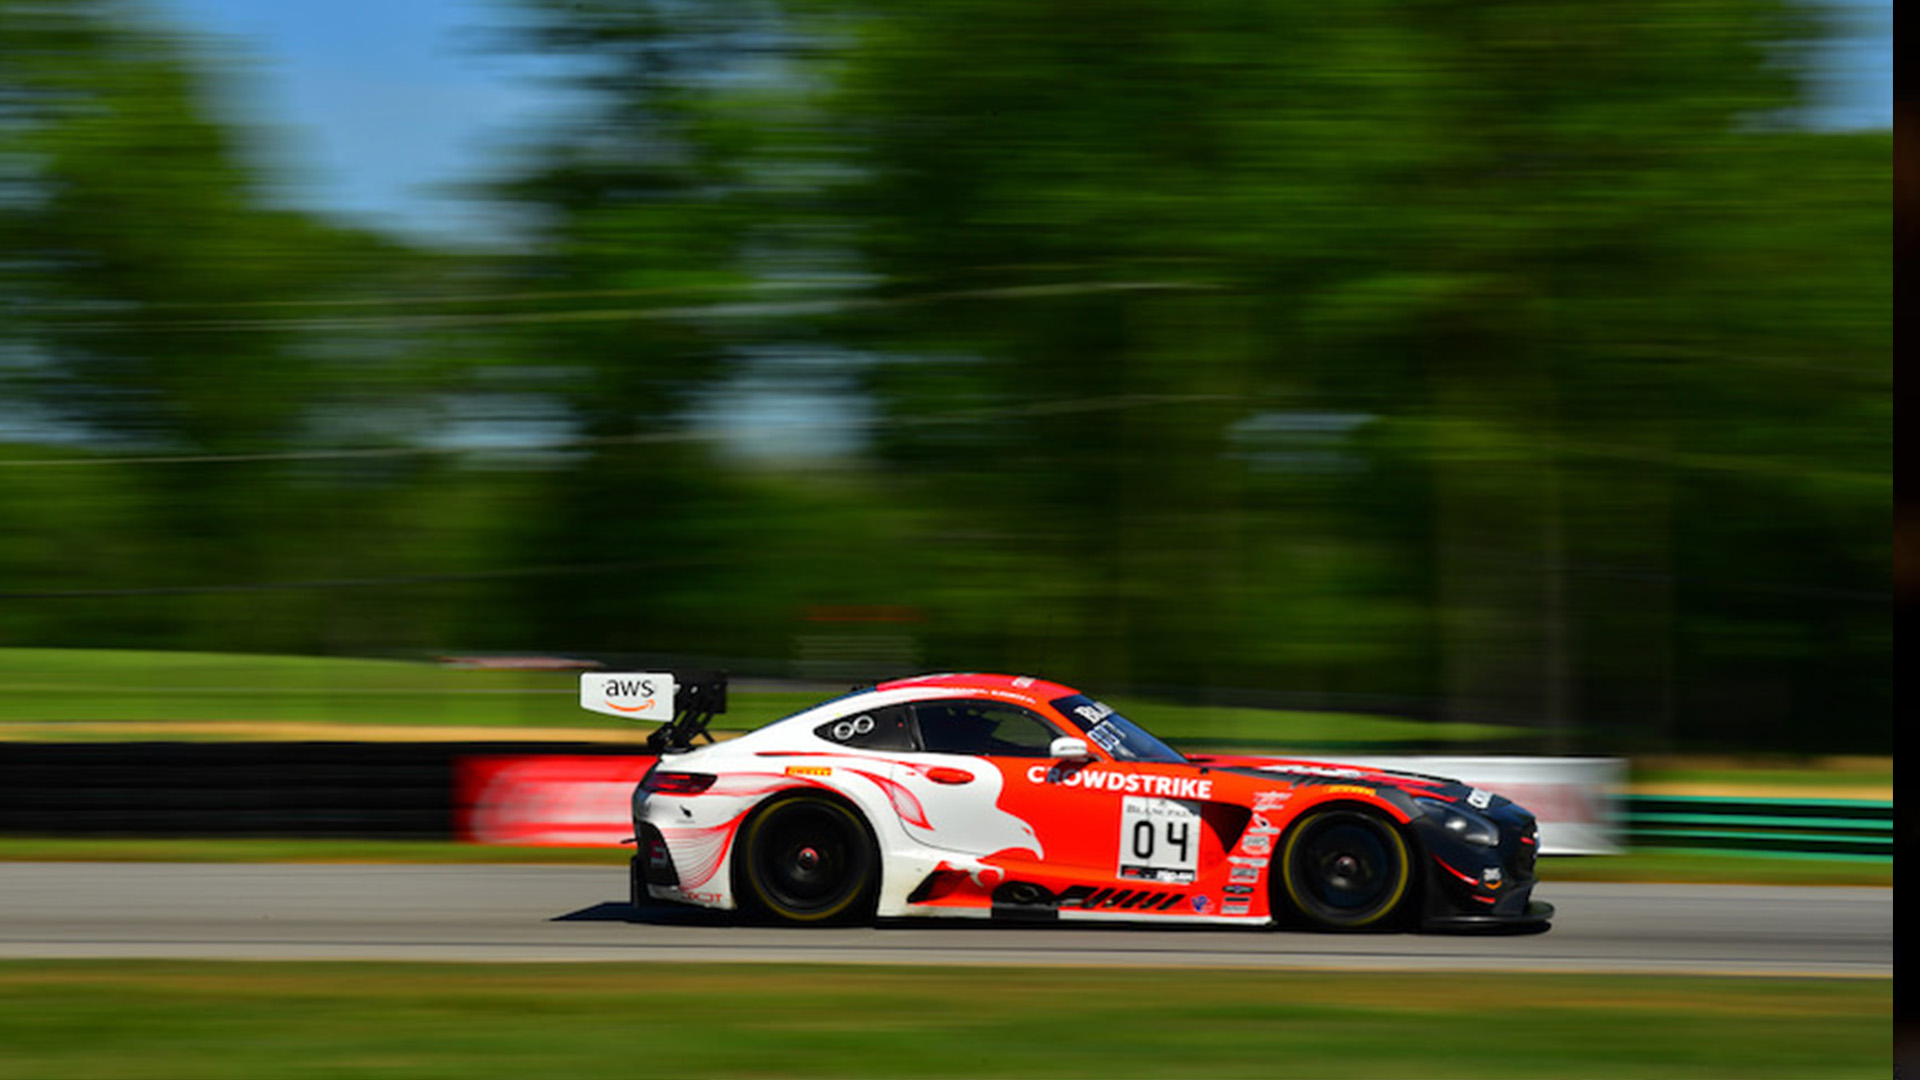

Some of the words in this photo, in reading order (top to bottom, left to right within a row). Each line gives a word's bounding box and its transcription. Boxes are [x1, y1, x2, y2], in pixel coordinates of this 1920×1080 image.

[606, 680, 654, 698] aws
[1027, 766, 1212, 798] CROWDSTRIKE
[1133, 820, 1188, 862] 04
